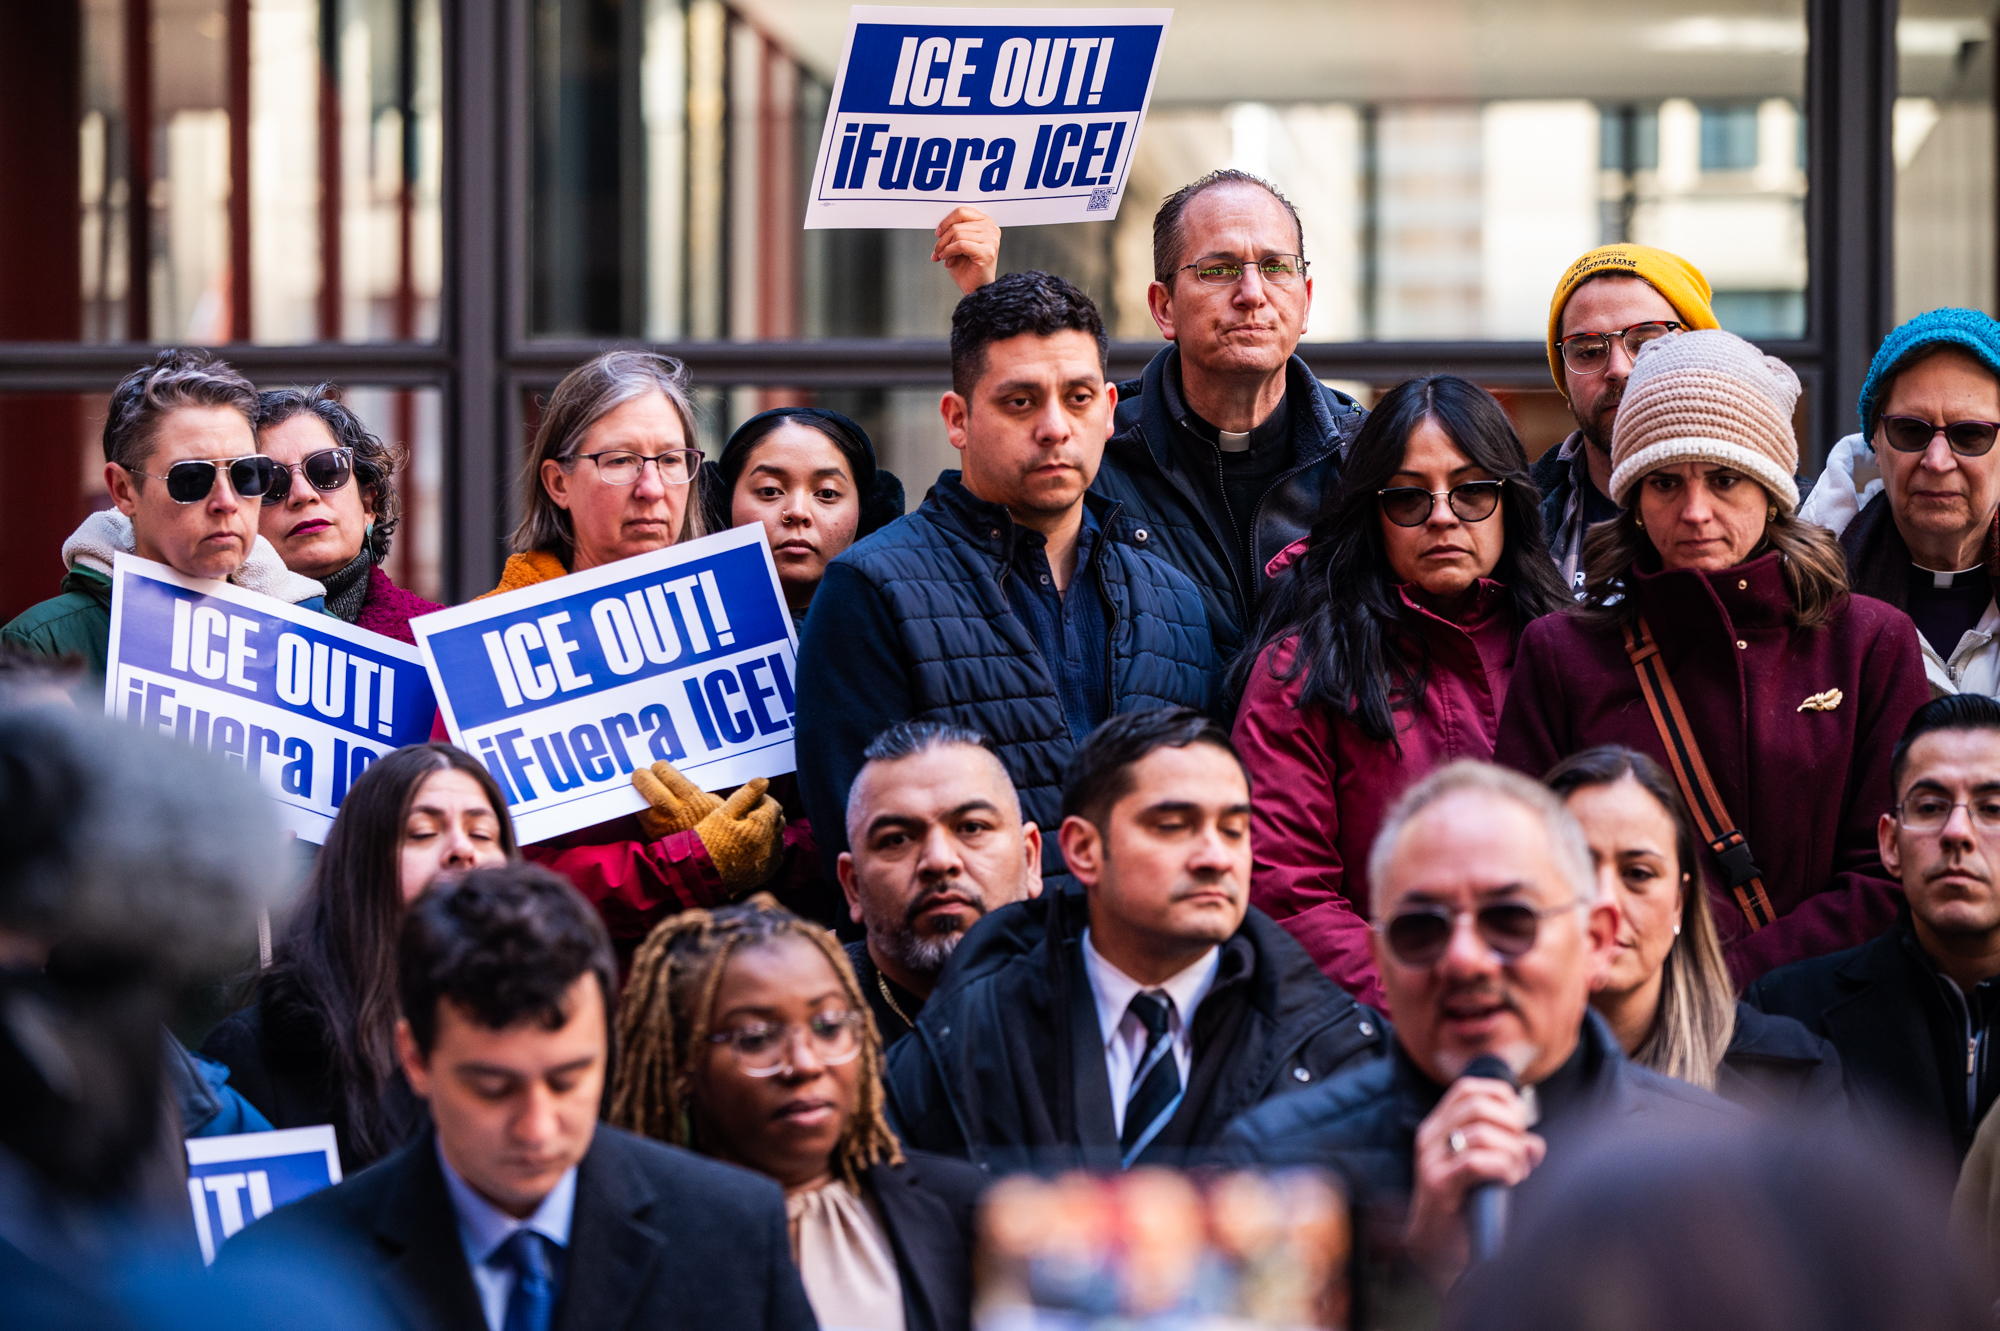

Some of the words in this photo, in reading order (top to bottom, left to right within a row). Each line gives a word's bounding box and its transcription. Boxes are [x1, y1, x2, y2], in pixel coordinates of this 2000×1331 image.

[889, 36, 983, 107] ICE
[990, 37, 1115, 107] OUT!
[832, 123, 1017, 192] ¡Fuera
[1024, 121, 1127, 190] ICE!
[170, 597, 260, 693] ICE
[275, 632, 395, 738] OUT!
[482, 610, 593, 709] ICE
[590, 569, 735, 675] OUT!
[477, 703, 687, 806] ¡Fuera
[682, 652, 795, 751] ICE!
